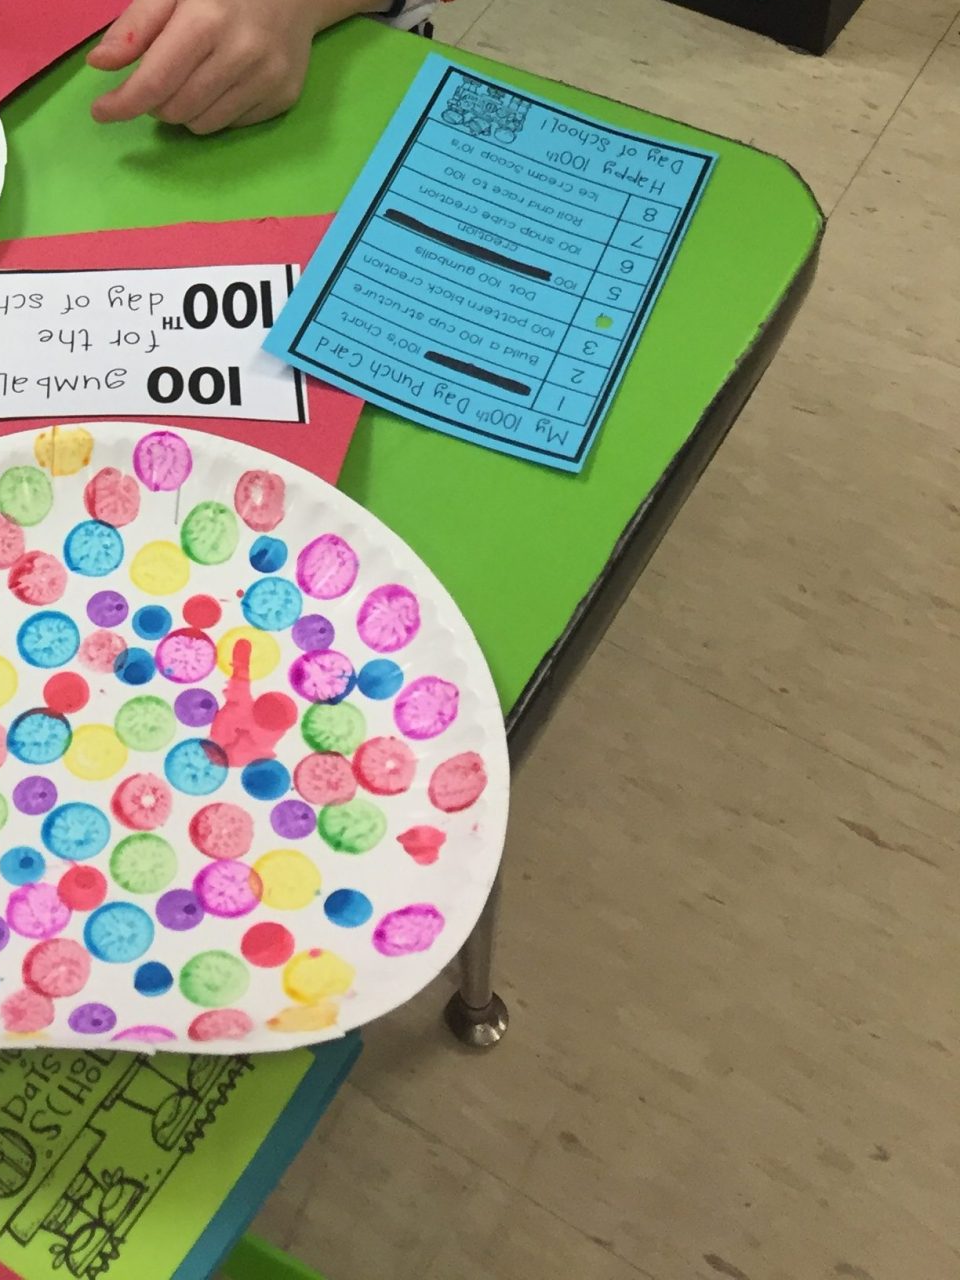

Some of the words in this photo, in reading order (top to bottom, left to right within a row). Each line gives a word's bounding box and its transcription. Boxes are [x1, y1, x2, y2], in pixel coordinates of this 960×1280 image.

[546, 150, 590, 172] 100th
[617, 144, 638, 158] of
[647, 146, 685, 175] Day
[480, 149, 523, 175] Scoop
[443, 166, 465, 181] 100
[471, 177, 488, 190] to
[527, 169, 574, 195] Cream
[603, 161, 666, 196] Happy
[418, 185, 478, 215] creation
[493, 186, 525, 205] race
[579, 187, 599, 202] Ice
[527, 199, 556, 216] and
[642, 207, 658, 222] 8
[481, 211, 517, 230] cube
[557, 211, 583, 228] Roll
[457, 223, 519, 253] creation
[520, 226, 555, 249] snap
[559, 241, 581, 255] 100
[630, 235, 644, 249] 7
[363, 254, 423, 286] creation
[414, 245, 475, 277] gumballs
[620, 259, 635, 274] 6
[478, 273, 502, 288] 100
[554, 276, 577, 290] 100
[108, 285, 164, 316] day
[352, 283, 425, 321] structure
[427, 282, 465, 305] block
[509, 283, 537, 301] Dot
[606, 286, 623, 301] 5
[60, 294, 90, 315] of
[467, 300, 529, 328] pattern
[341, 311, 382, 337] Chart
[428, 317, 456, 333] cup
[531, 323, 555, 339] 100
[38, 329, 93, 353] the
[110, 329, 160, 353] for
[386, 332, 422, 355] 100's
[459, 330, 484, 346] 100
[489, 341, 500, 350] a
[582, 340, 598, 355] 3
[314, 335, 364, 368] Card
[503, 346, 540, 366] Build
[147, 365, 242, 407] 100
[369, 359, 425, 398] Punch
[570, 367, 585, 384] 2
[433, 382, 470, 415] Day
[556, 395, 566, 412] 1
[476, 408, 523, 433] 100th
[534, 418, 570, 447] My
